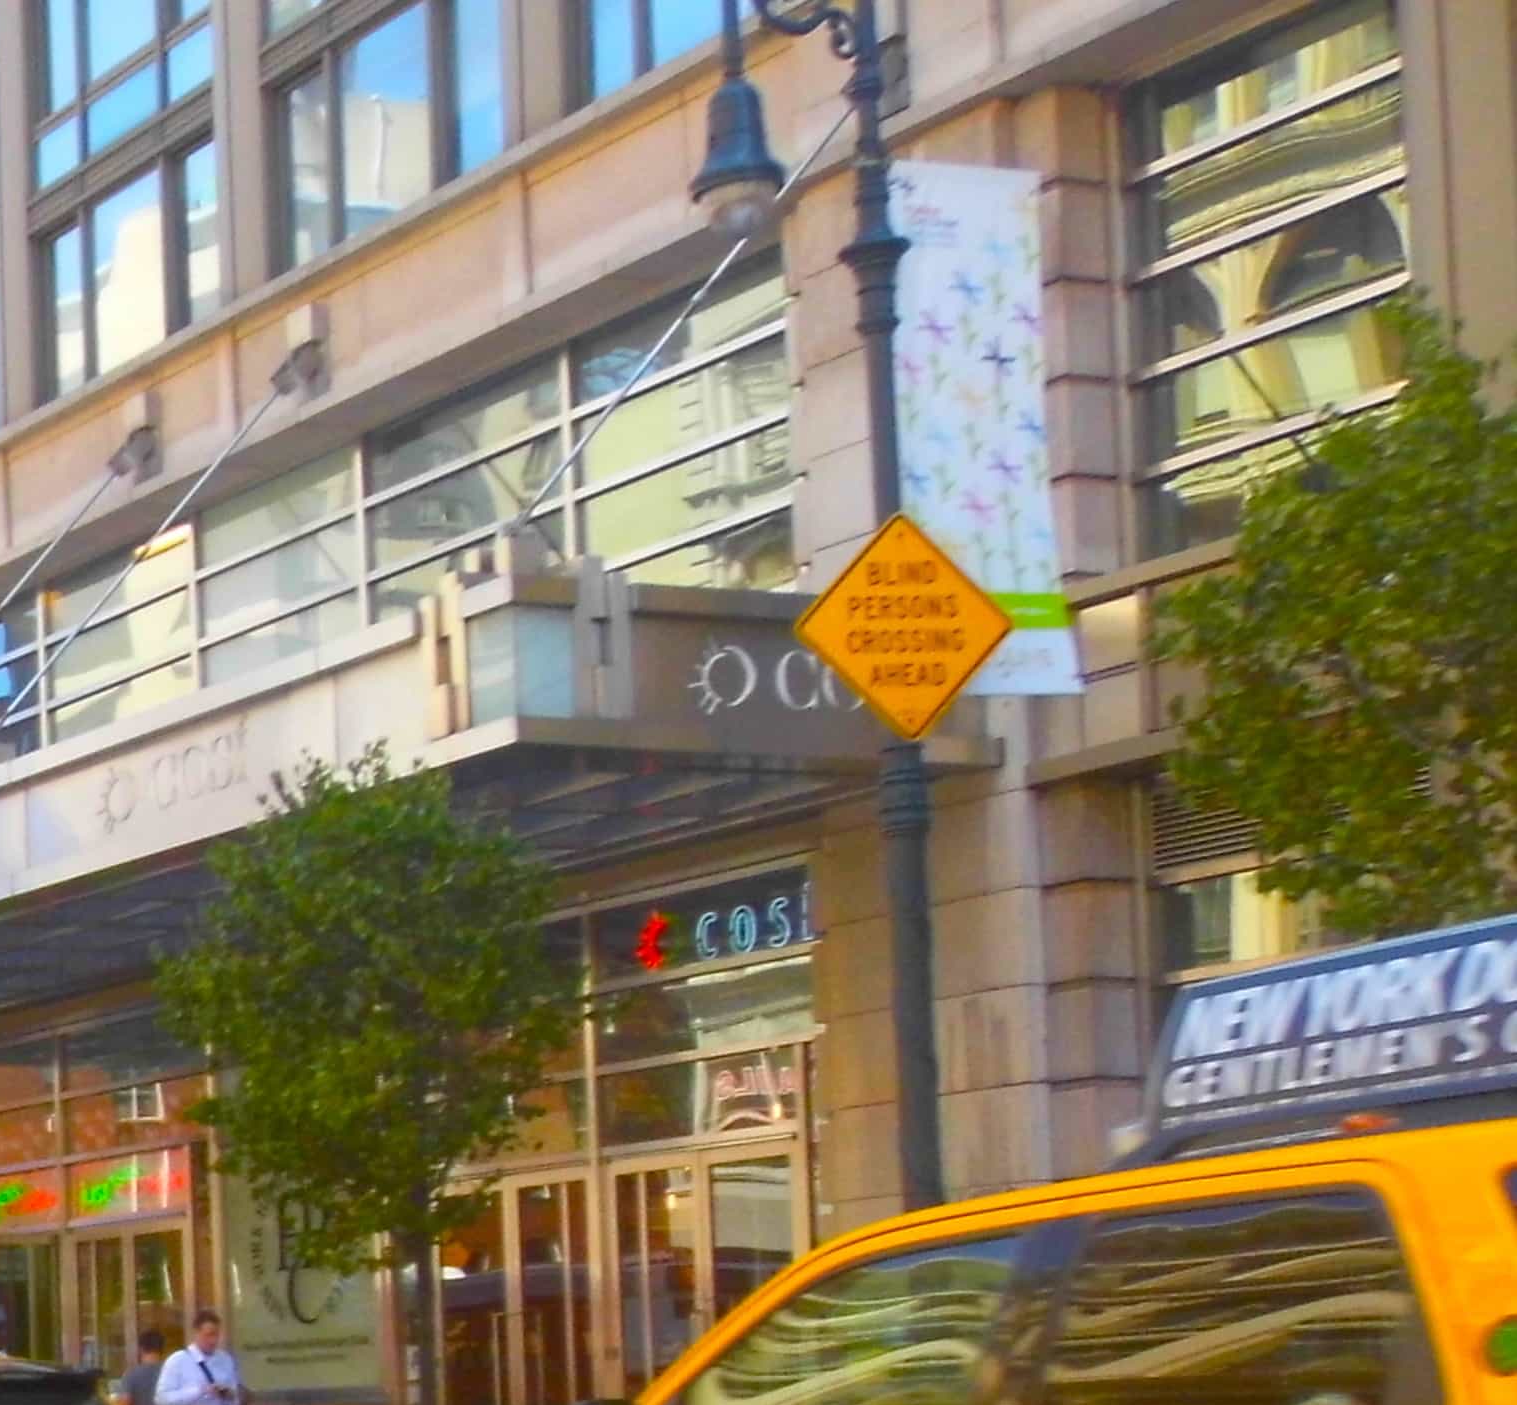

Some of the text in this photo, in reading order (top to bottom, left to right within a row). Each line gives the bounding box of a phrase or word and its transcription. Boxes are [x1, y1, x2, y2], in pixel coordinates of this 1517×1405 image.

[868, 560, 937, 586] BLIND
[847, 594, 959, 621] PERSONS
[846, 627, 966, 655] CROSSING
[870, 661, 948, 687] AHEAD
[1171, 978, 1310, 1063] NEW
[1302, 946, 1463, 1039] YORK
[1163, 1013, 1492, 1109] GENTLEMEN'S
